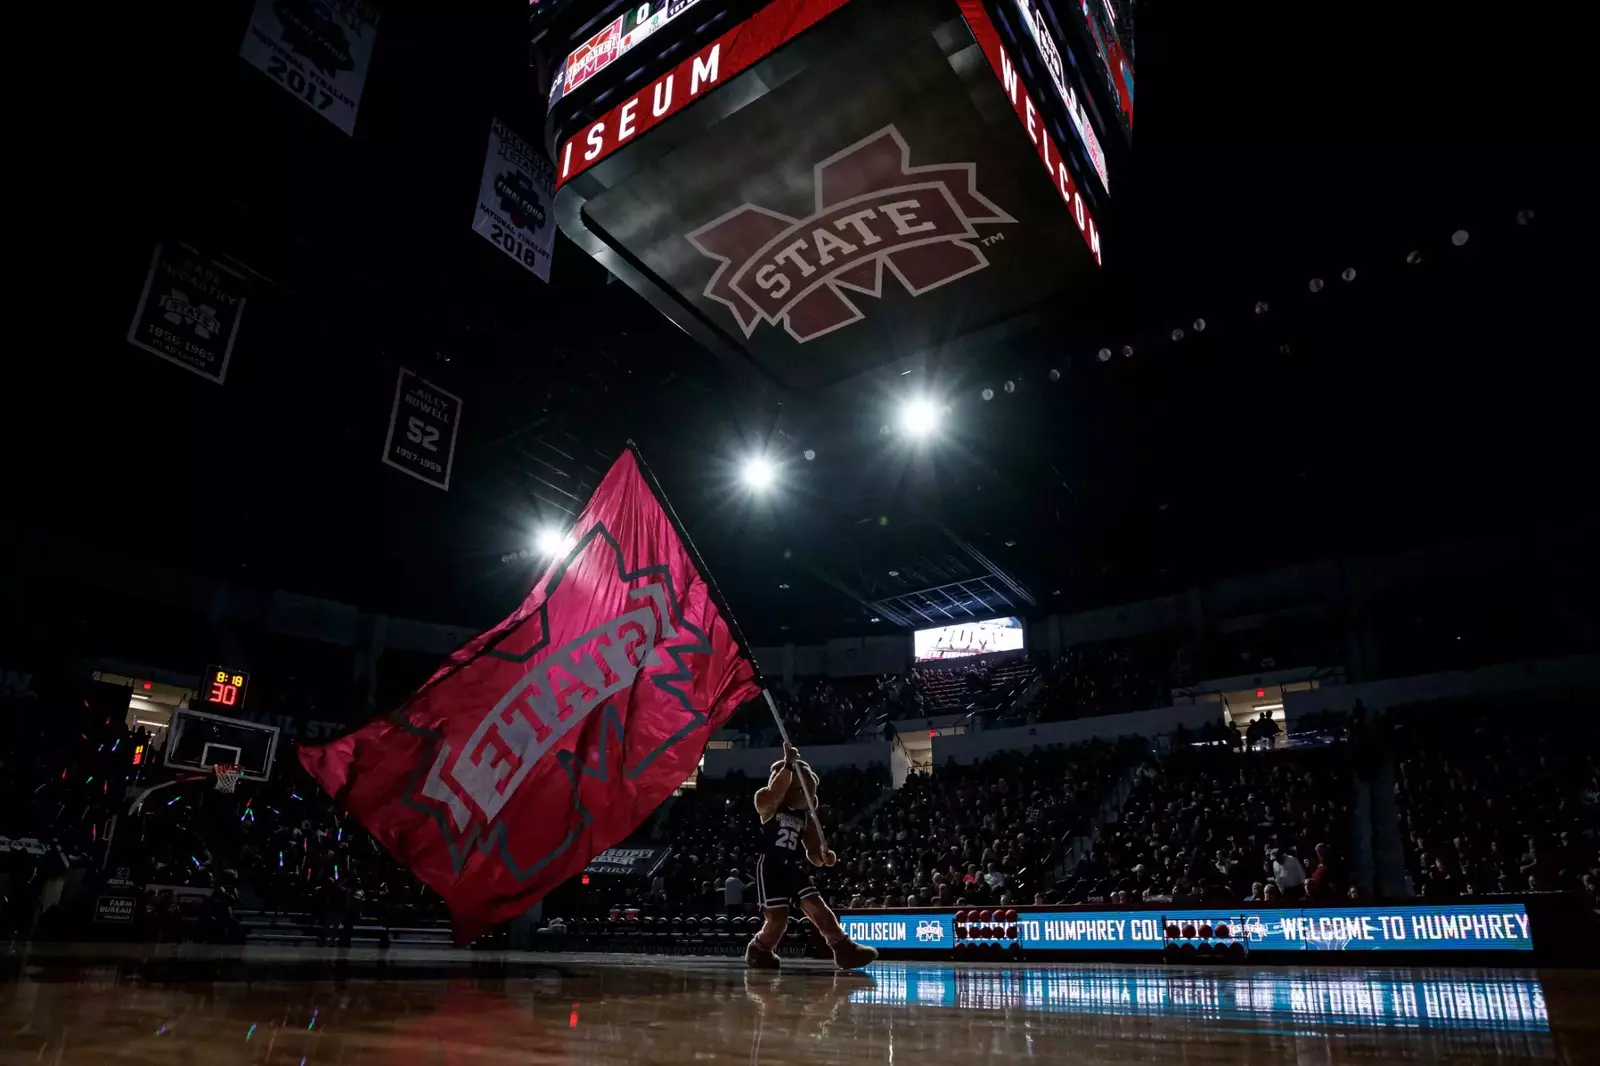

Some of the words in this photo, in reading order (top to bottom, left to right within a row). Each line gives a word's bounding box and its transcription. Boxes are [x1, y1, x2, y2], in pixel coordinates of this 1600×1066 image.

[267, 55, 334, 110] 2017
[479, 202, 516, 235] NATIONAL
[518, 231, 551, 260] FINALIST
[490, 222, 535, 268] 2018
[755, 199, 937, 299] STATE
[980, 232, 1005, 248] TM
[408, 388, 449, 410] AILEY
[406, 415, 440, 453] 52
[217, 671, 243, 687] 8:18
[210, 682, 237, 705] 30
[775, 828, 799, 851] 25
[99, 906, 132, 914] BUREAU
[109, 899, 133, 907] FARM
[849, 922, 907, 941] COLISEUM
[1021, 920, 1040, 941] TO
[1044, 920, 1126, 941] HUMPHREY
[1280, 916, 1374, 940] WELCOME
[1378, 915, 1407, 940] TO
[1412, 913, 1530, 940] HUMPHREY
